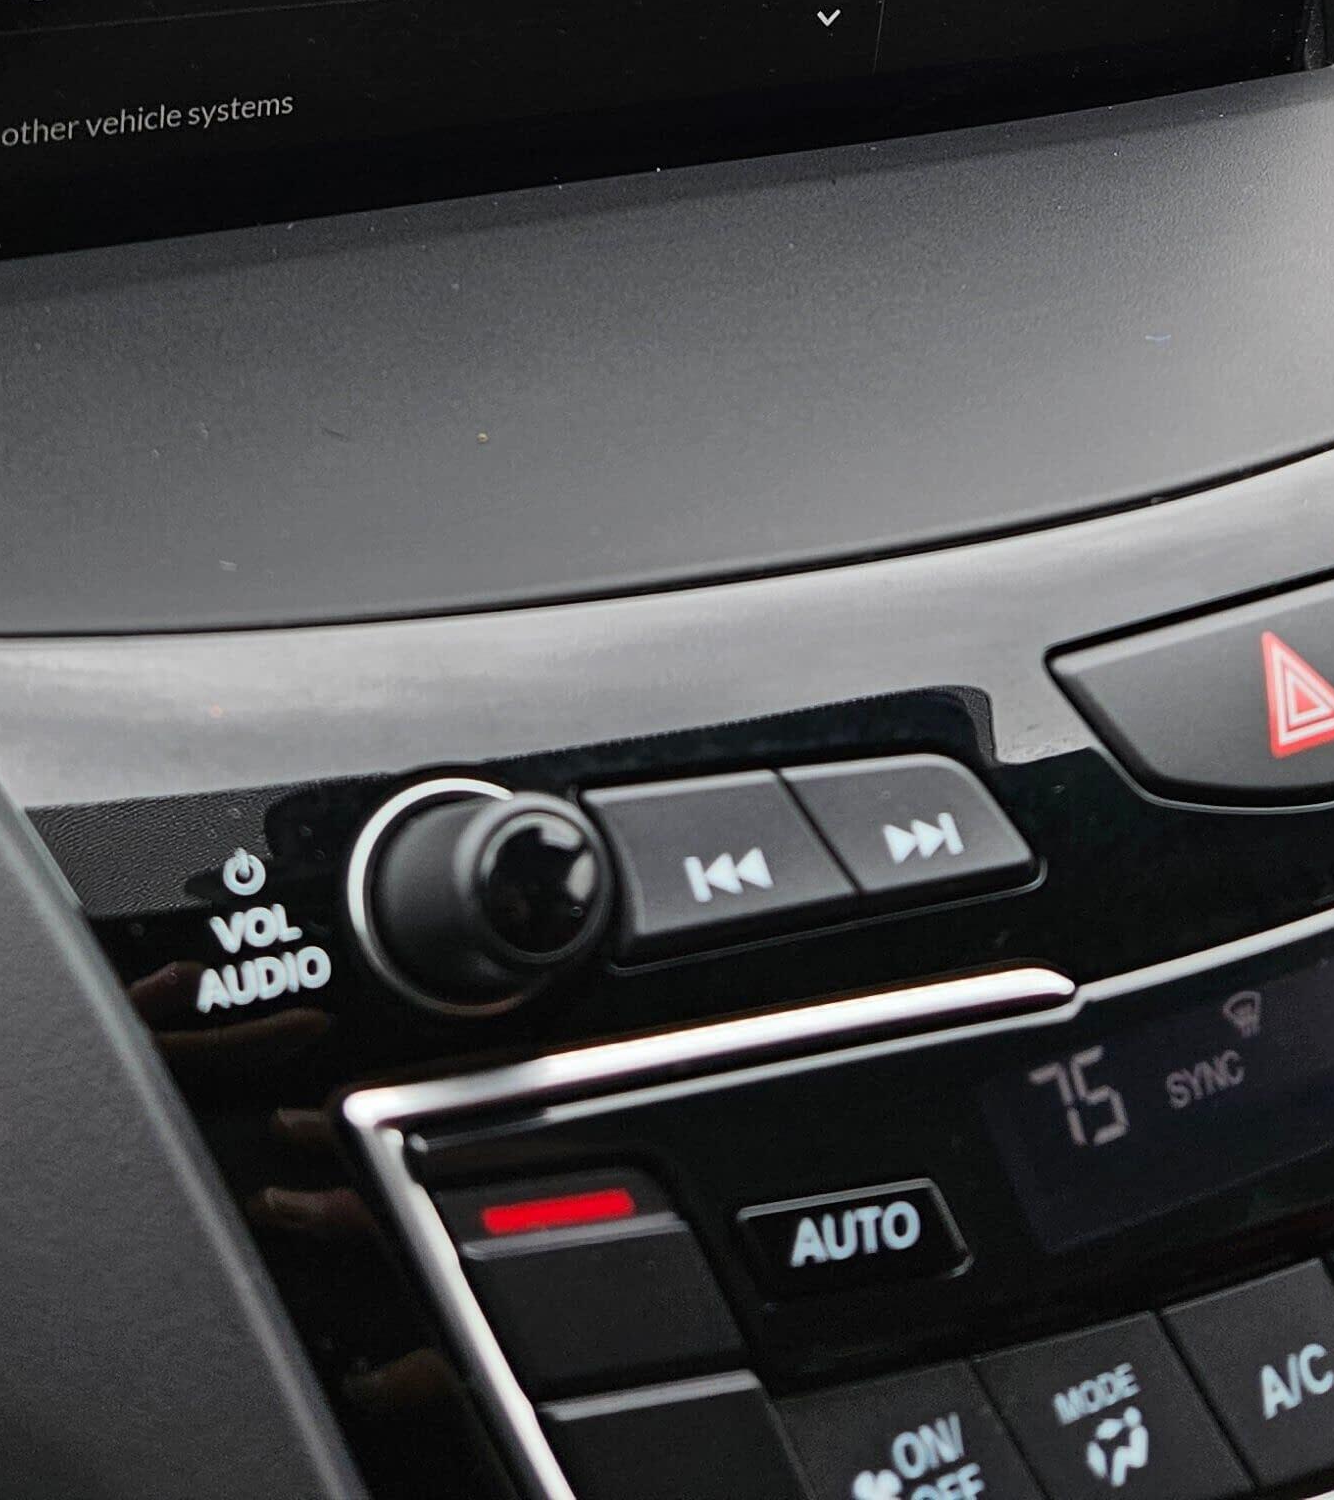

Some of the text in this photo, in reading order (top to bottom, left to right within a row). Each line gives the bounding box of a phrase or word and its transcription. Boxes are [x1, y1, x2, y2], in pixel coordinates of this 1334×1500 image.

[0, 117, 80, 148] other
[84, 103, 183, 139] vehicle
[187, 95, 294, 130] systems
[210, 902, 303, 954] VOL
[196, 946, 331, 1013] AUDIO
[1030, 1045, 1245, 1147] 75 SYNC
[790, 1201, 921, 1268] AUTO
[1053, 1362, 1141, 1427] MODE
